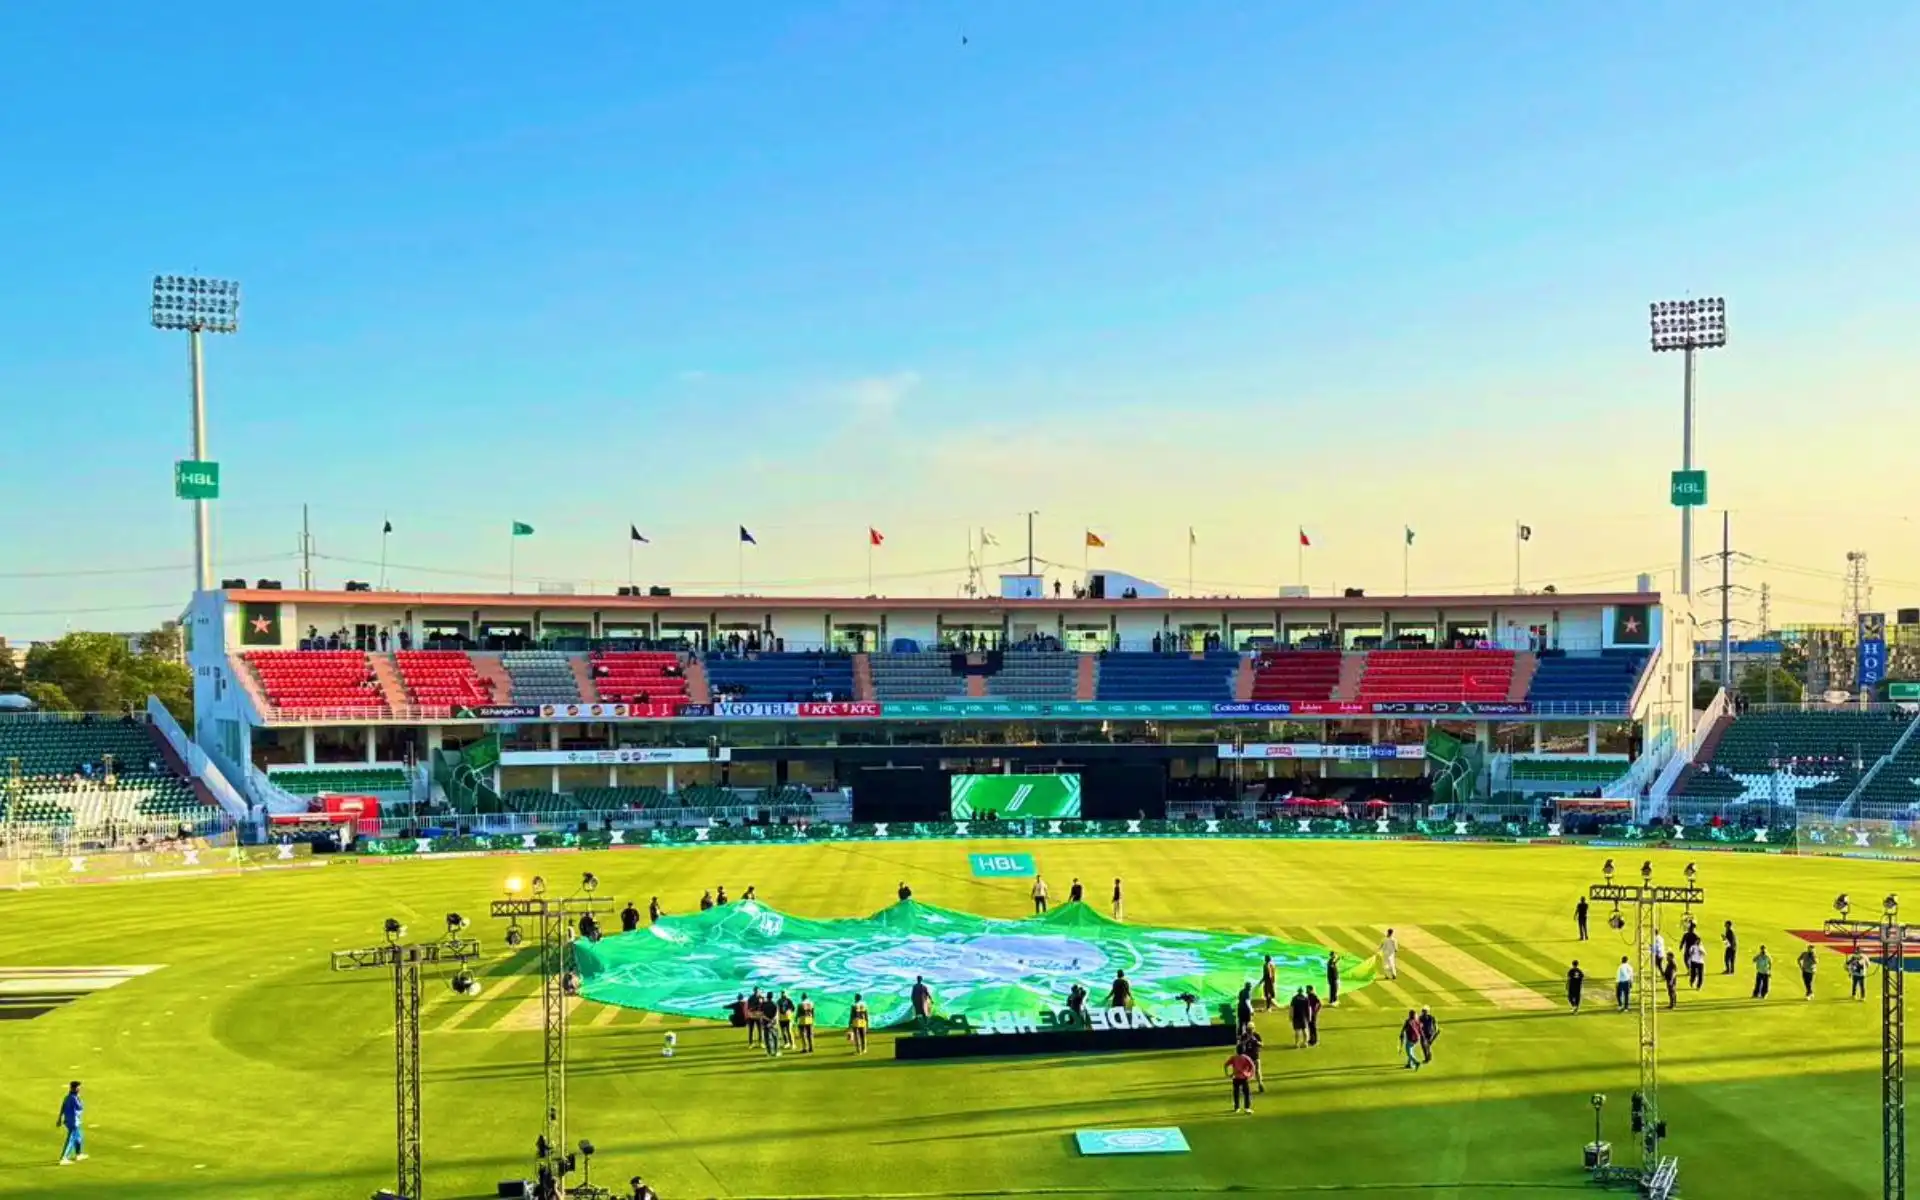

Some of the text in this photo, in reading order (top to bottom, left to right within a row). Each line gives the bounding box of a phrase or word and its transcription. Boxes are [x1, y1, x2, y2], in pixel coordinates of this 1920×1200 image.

[182, 473, 216, 485] HBL
[1672, 482, 1702, 493] HBL
[720, 703, 755, 715] VGO
[812, 704, 837, 714] KFC
[850, 704, 876, 714] KFC
[979, 856, 1024, 871] HBL
